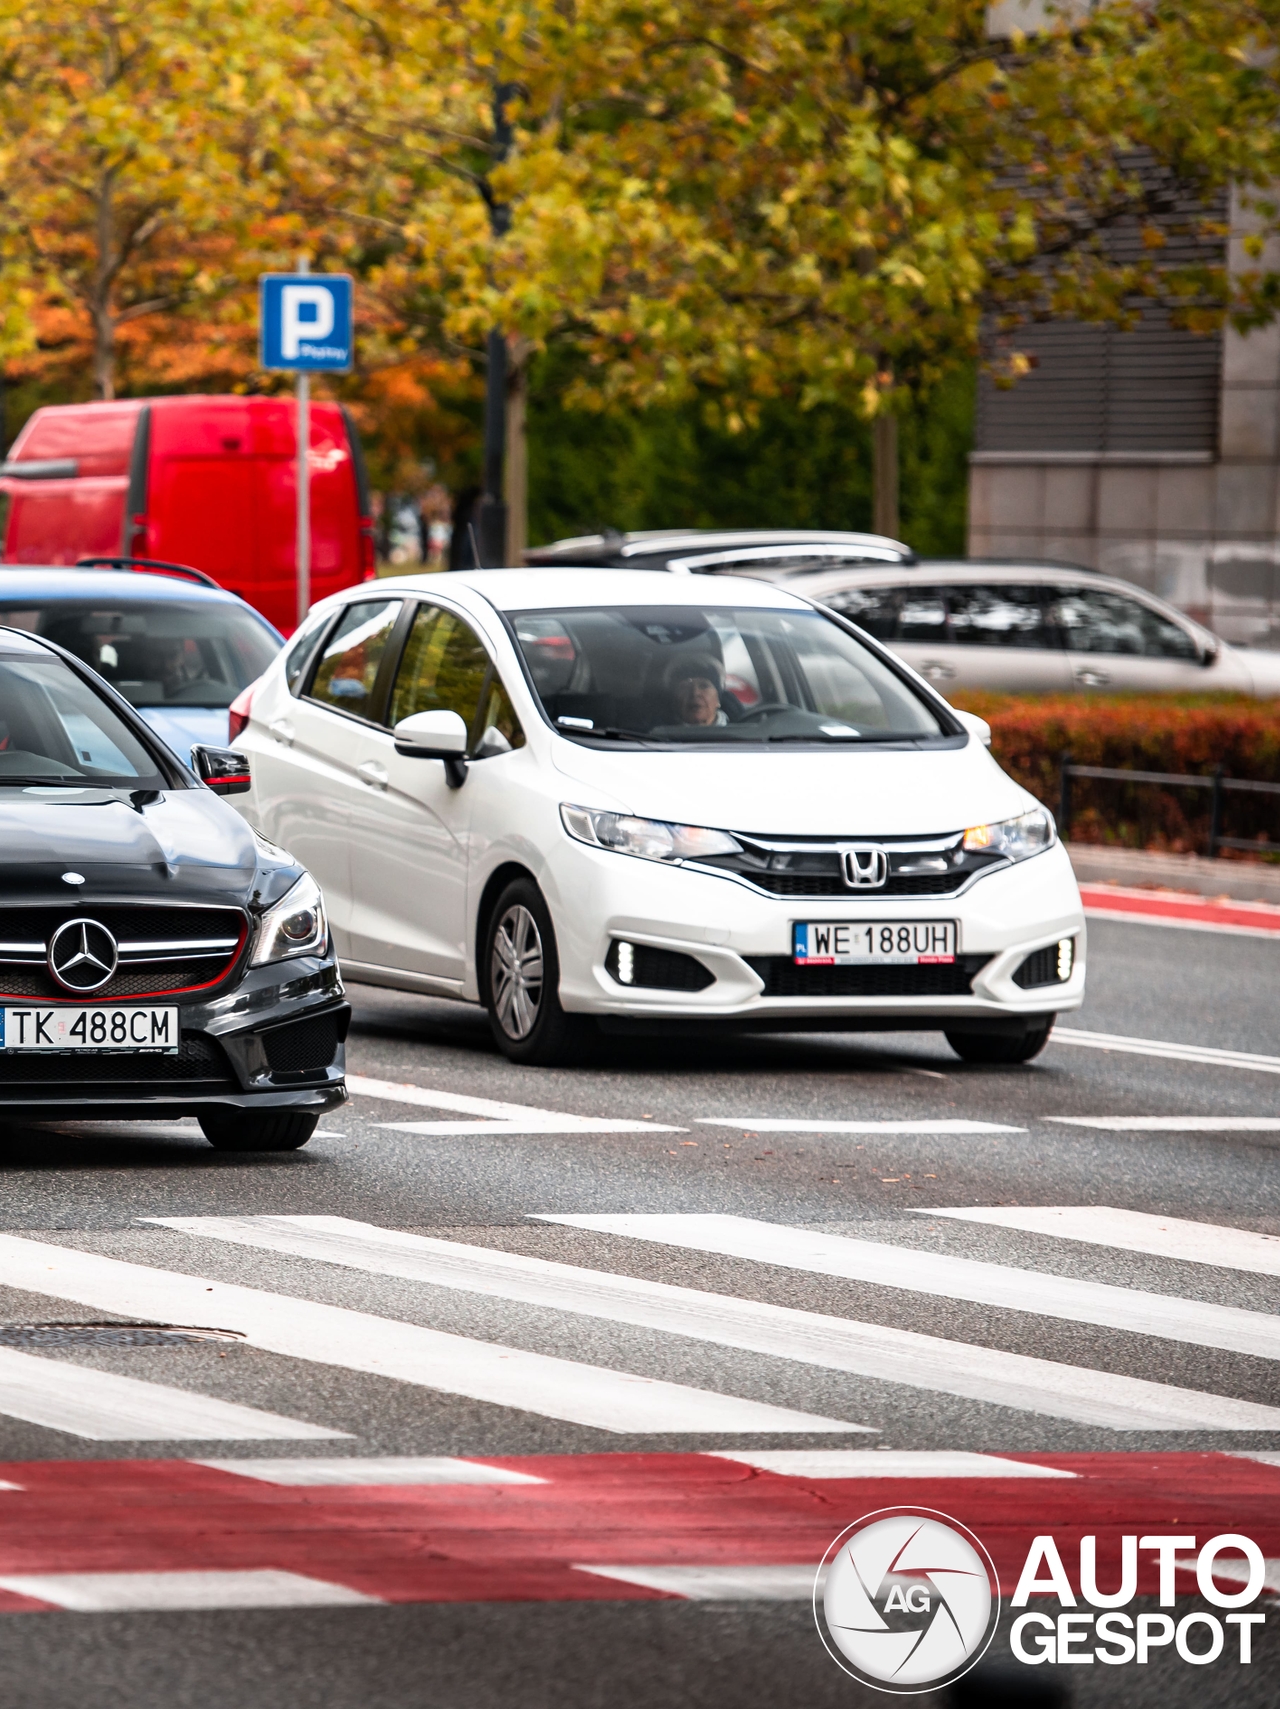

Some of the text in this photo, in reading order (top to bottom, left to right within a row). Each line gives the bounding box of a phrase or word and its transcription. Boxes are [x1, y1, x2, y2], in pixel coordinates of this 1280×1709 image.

[281, 285, 335, 360] P
[796, 943, 807, 953] PL
[814, 926, 948, 954] WE 188UH
[12, 1011, 169, 1044] TK 488CM
